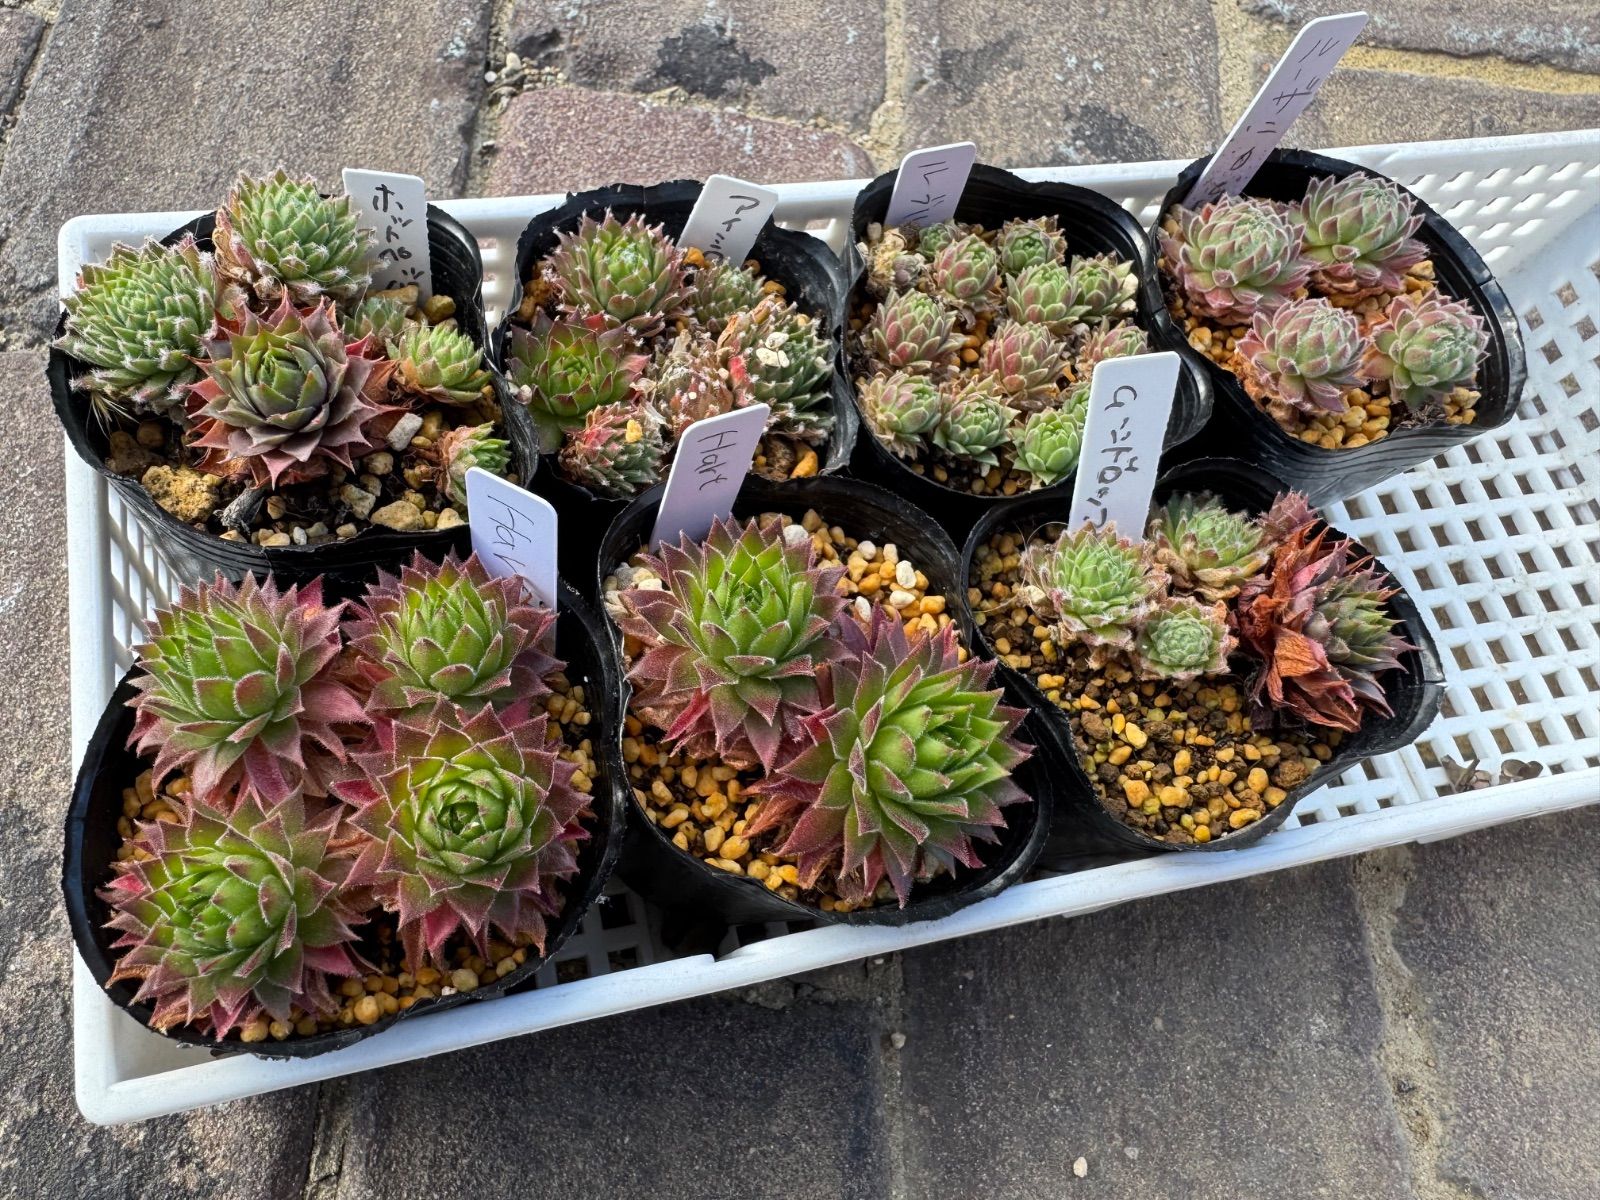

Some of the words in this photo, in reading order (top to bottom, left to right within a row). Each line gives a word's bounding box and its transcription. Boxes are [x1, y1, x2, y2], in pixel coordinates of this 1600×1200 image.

[372, 183, 426, 291] ホットペッ
